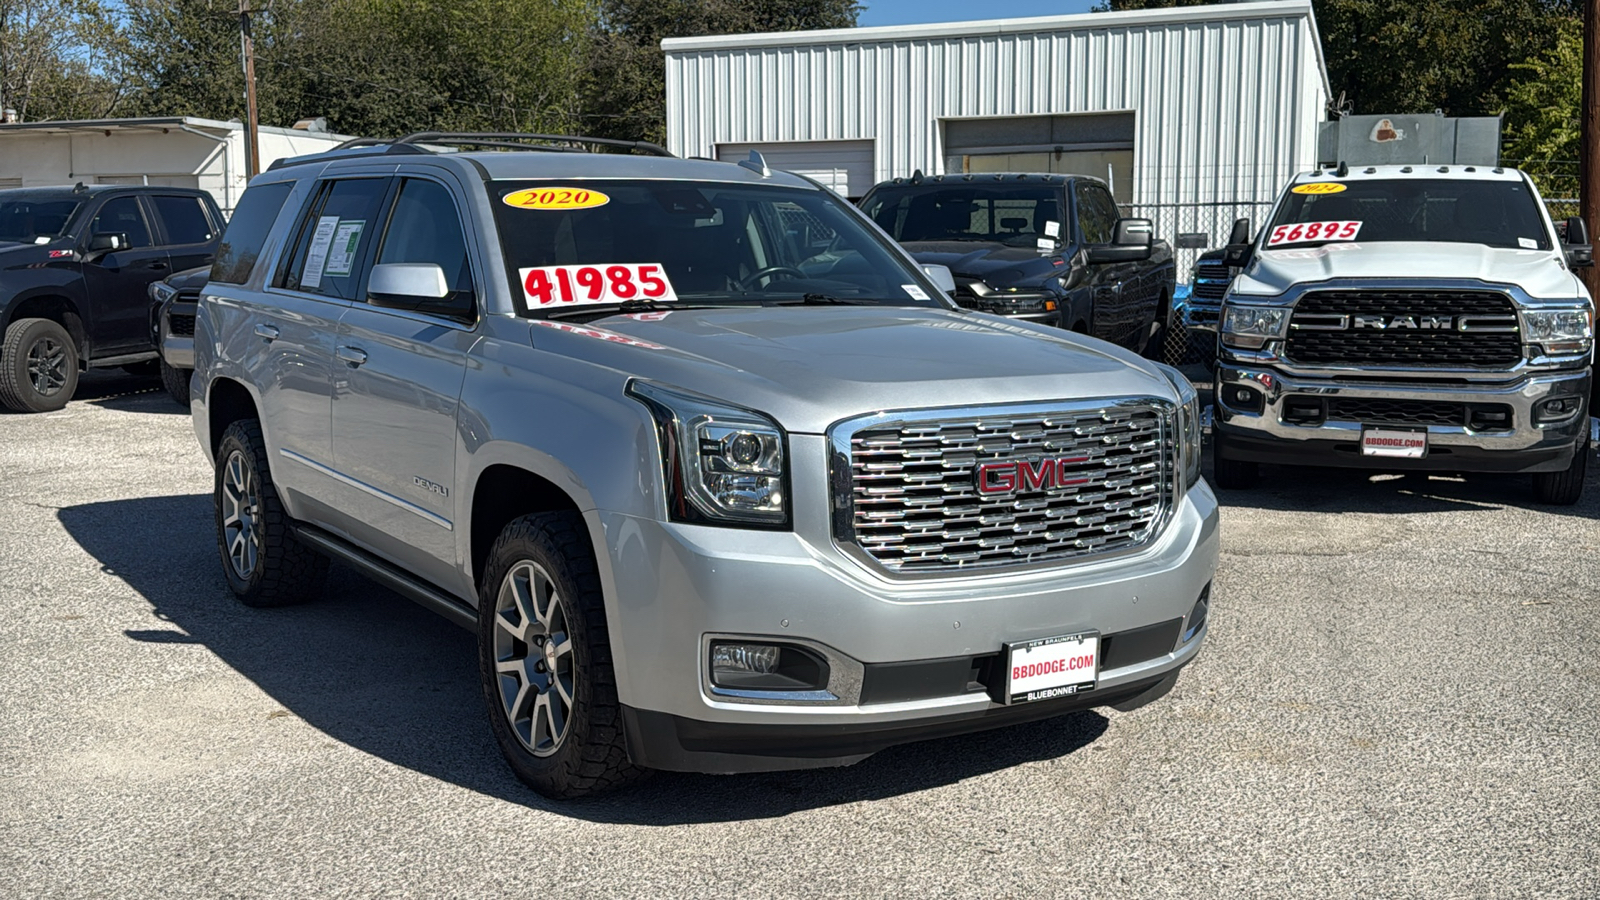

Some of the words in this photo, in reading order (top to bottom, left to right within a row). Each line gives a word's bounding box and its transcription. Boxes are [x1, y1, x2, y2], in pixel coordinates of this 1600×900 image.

[1298, 184, 1340, 192] 2024
[522, 191, 590, 205] 2020
[1270, 222, 1359, 243] 56895
[48, 249, 73, 258] Z71
[525, 265, 667, 304] 41985
[1354, 315, 1452, 329] RAM
[1365, 437, 1423, 447] BBDODGE.COM
[979, 456, 1090, 493] GMC
[413, 475, 449, 497] DENALI
[1045, 634, 1082, 645] BRAUNFELS
[1012, 654, 1094, 680] BBDODGE.COM
[1027, 685, 1078, 701] BLUEBONNET
